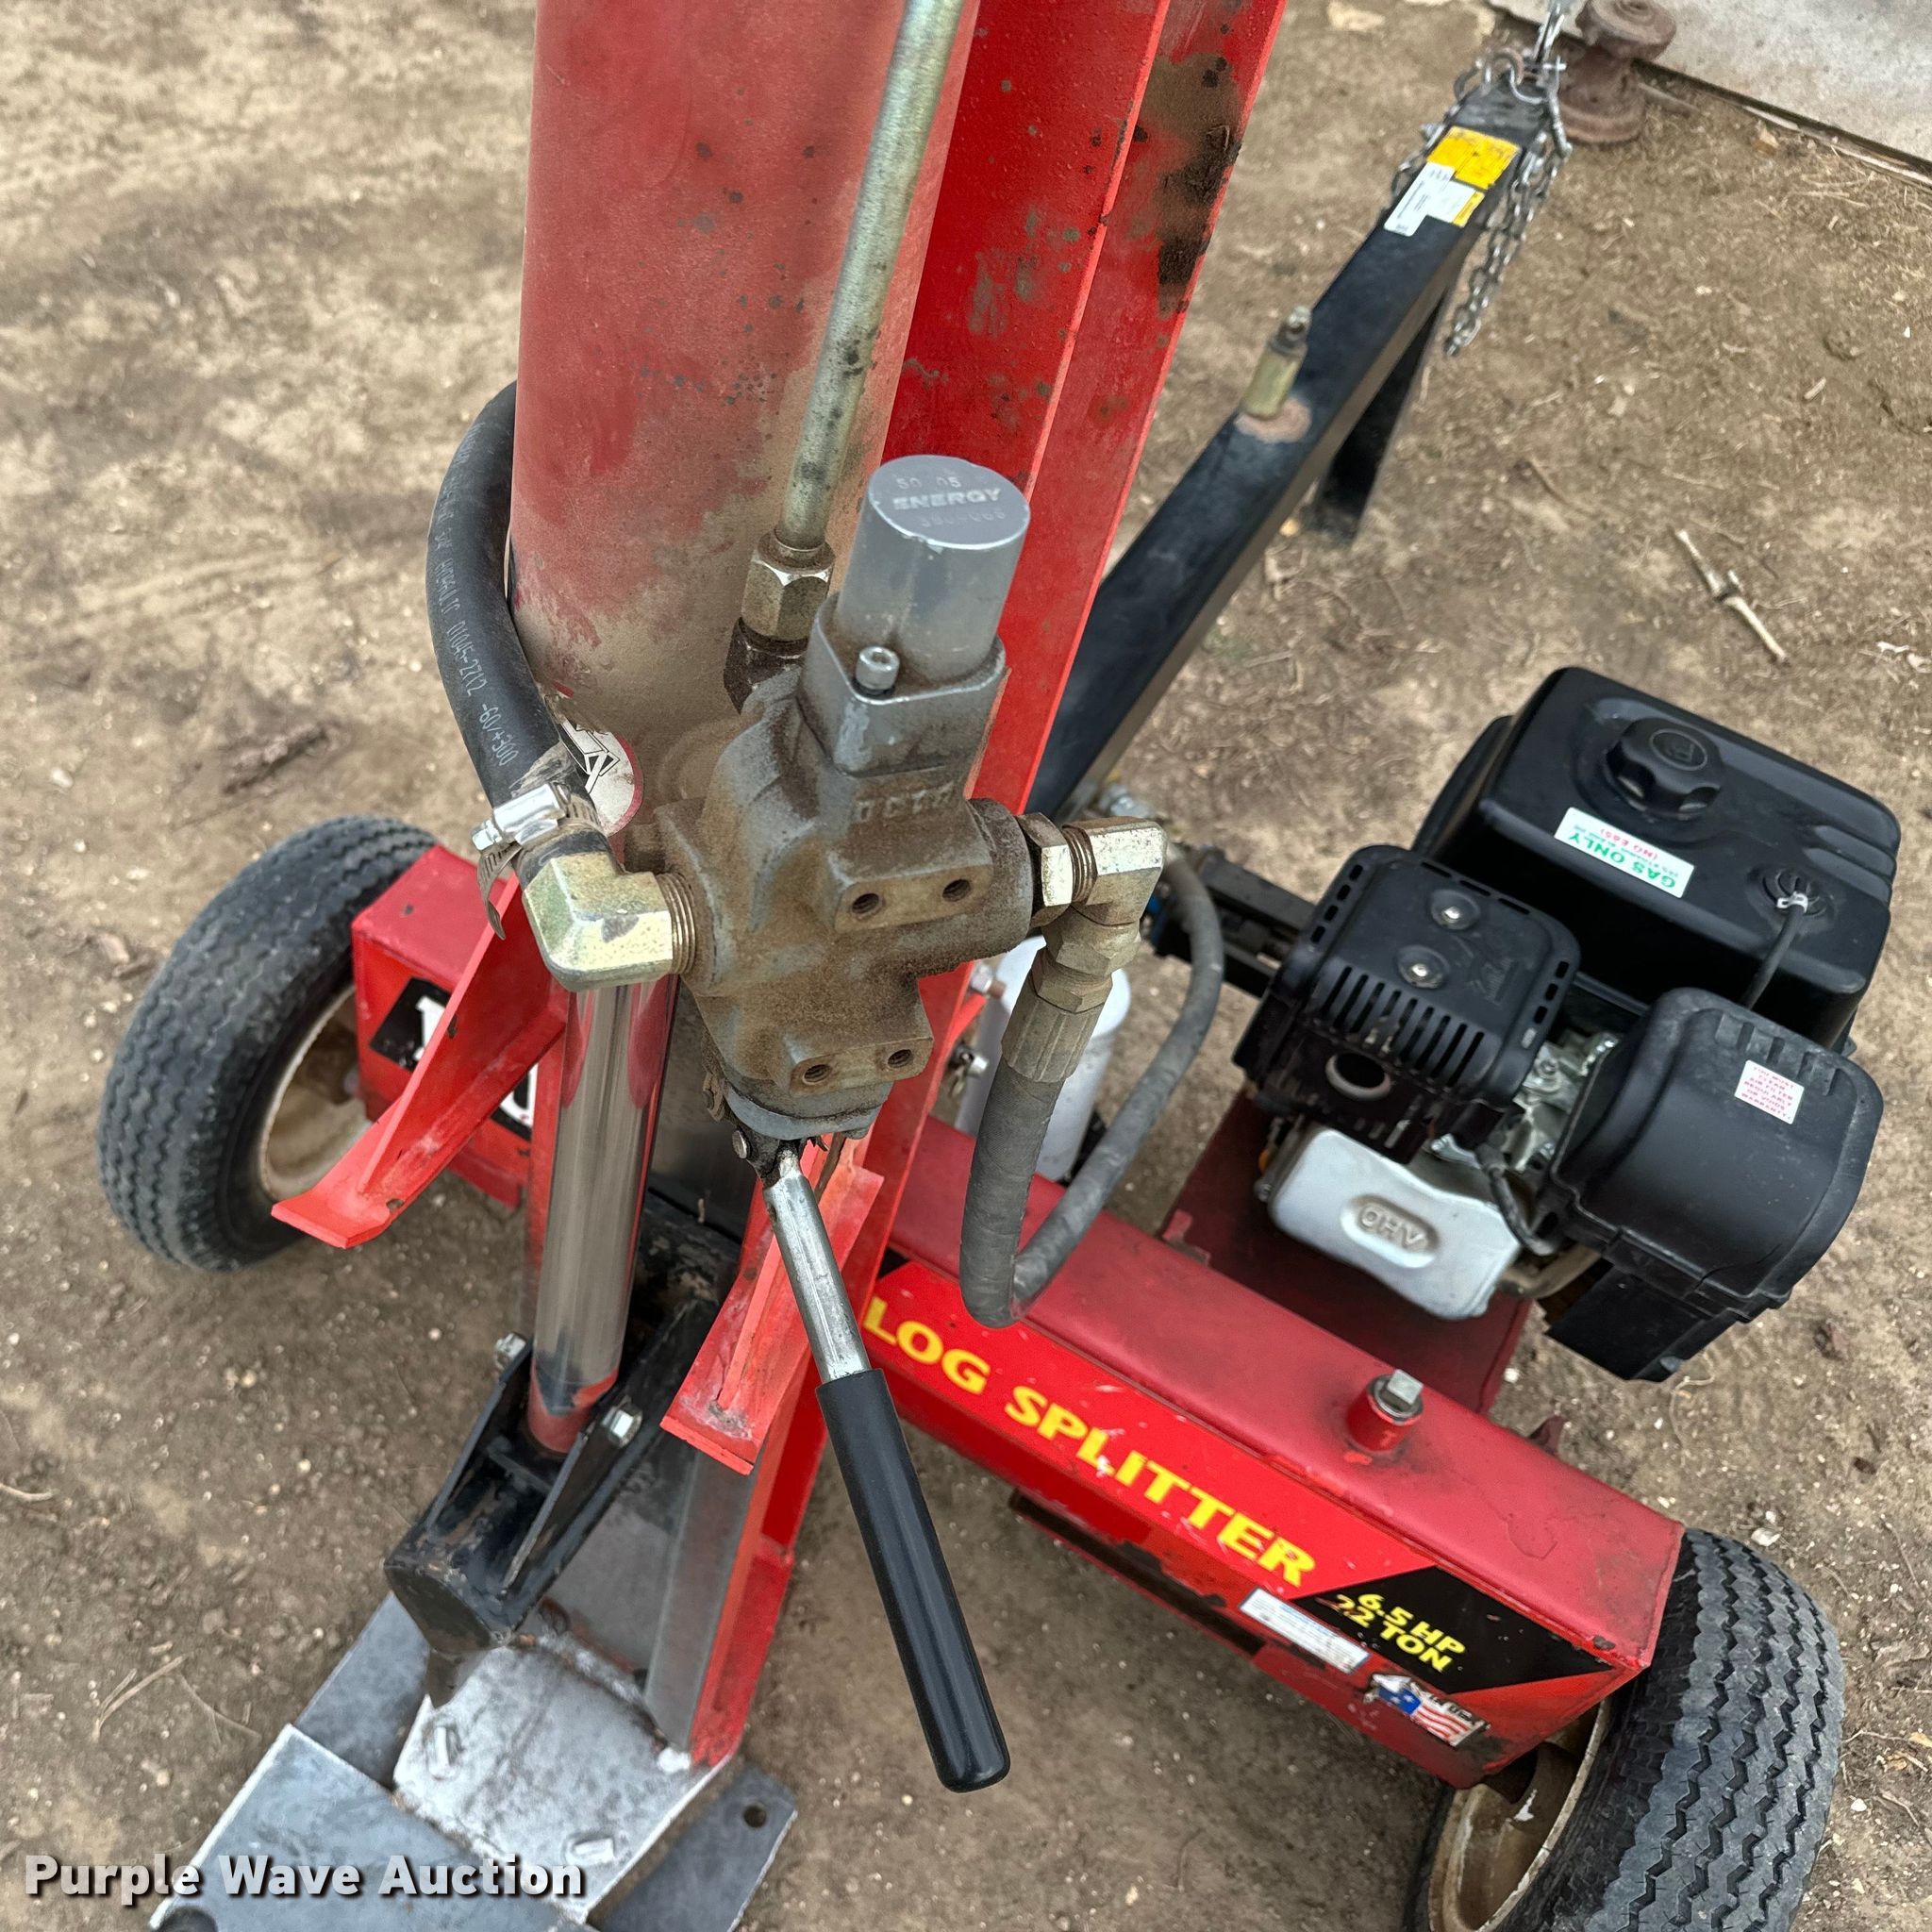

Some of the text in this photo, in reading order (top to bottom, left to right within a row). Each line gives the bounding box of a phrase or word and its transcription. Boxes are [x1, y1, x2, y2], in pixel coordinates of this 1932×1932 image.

[892, 487, 1002, 510] ENERGY
[1569, 831, 1625, 864] ONLY
[1632, 861, 1676, 889] GAS
[1358, 1203, 1426, 1249] OHV
[863, 1297, 1316, 1588] LOG SPLITTER
[1336, 1593, 1375, 1628] 22
[1379, 1621, 1452, 1674] TON
[1357, 1593, 1466, 1654] 6.5 HP
